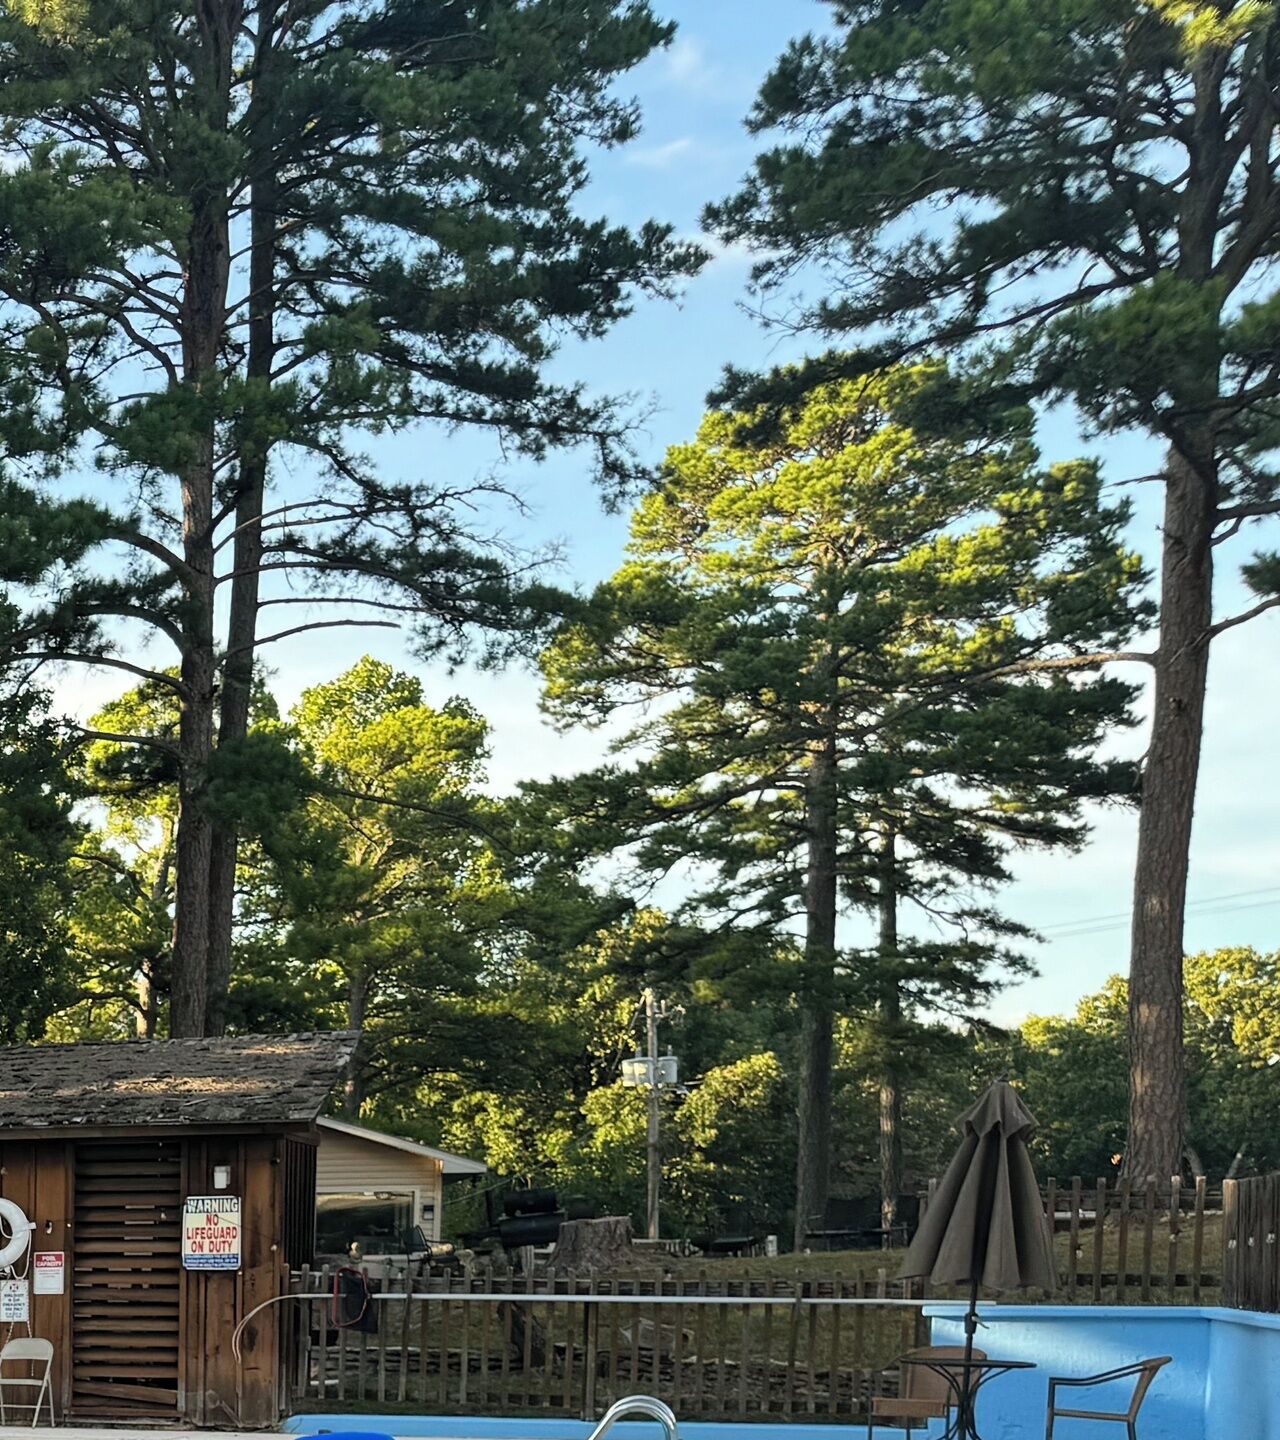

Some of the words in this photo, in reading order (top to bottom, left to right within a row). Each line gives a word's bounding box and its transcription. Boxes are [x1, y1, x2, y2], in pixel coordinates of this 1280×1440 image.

[187, 1198, 238, 1213] WARNING
[206, 1213, 219, 1226] NO
[186, 1226, 238, 1240] LIFEGUARD
[191, 1240, 204, 1253] ON
[209, 1240, 233, 1253] DUTY
